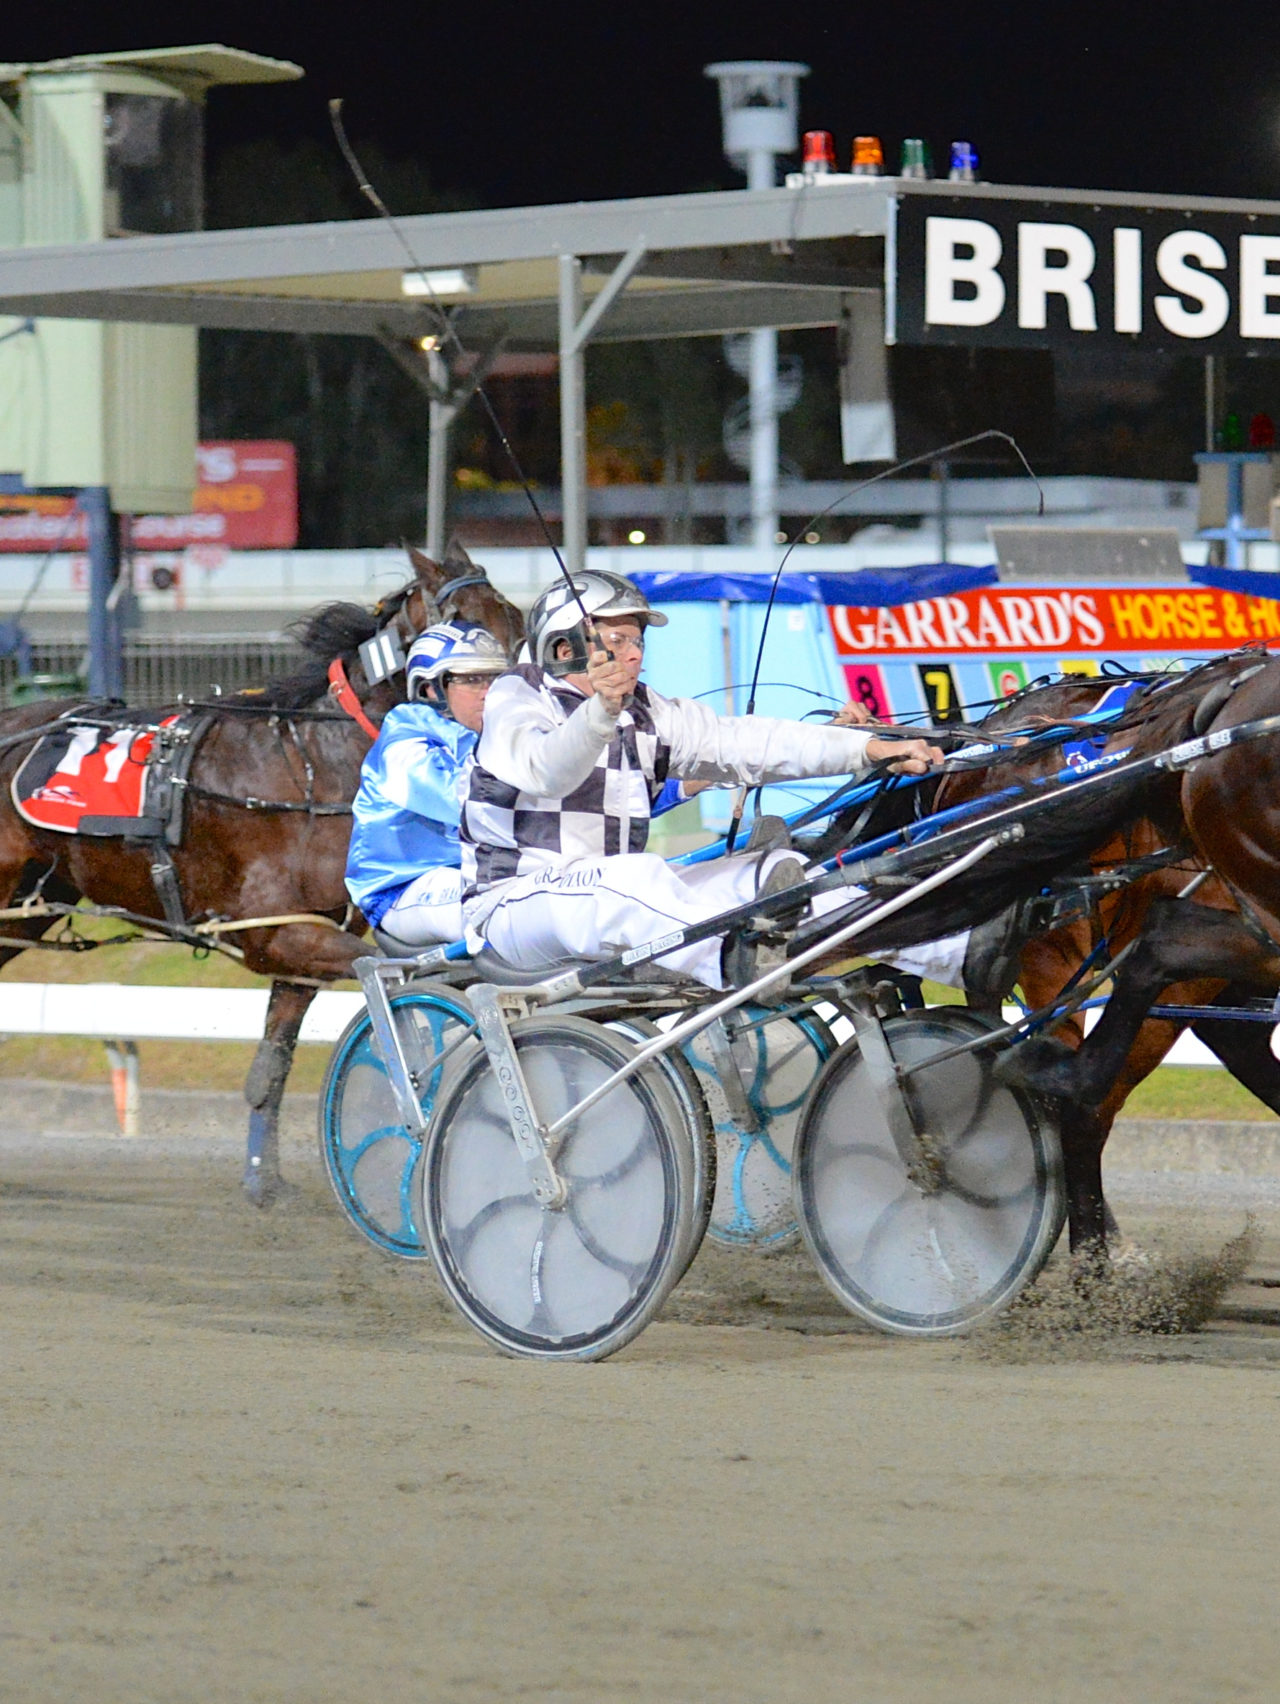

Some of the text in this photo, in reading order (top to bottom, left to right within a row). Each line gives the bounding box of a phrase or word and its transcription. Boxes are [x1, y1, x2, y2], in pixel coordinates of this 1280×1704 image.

[832, 591, 1105, 650] GARRARD'S
[1109, 593, 1223, 639] HORSE
[1222, 592, 1249, 638] &
[855, 675, 879, 716] 8
[924, 671, 950, 720] 7
